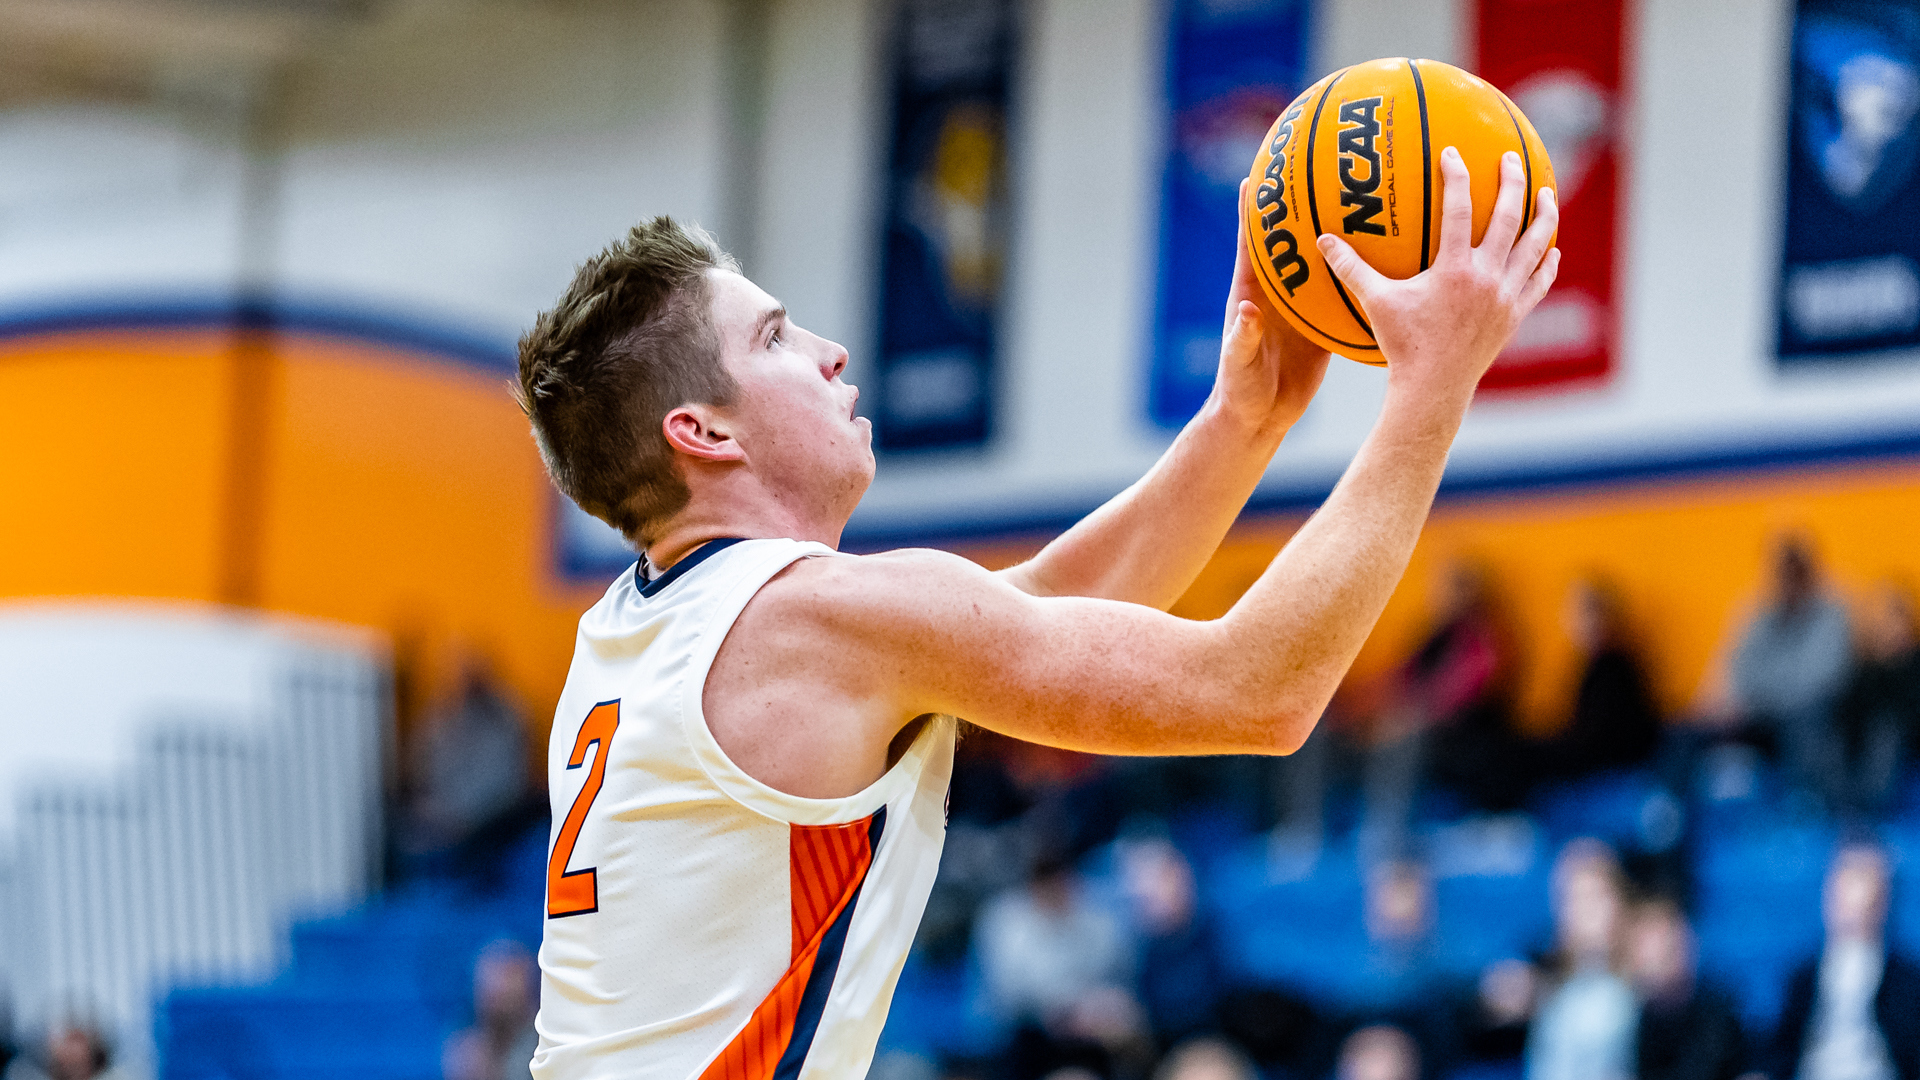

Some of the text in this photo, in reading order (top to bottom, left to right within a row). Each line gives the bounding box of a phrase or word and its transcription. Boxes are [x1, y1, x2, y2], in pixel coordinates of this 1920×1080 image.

[1256, 92, 1312, 298] Wilson
[1337, 95, 1387, 237] NCAA
[1386, 96, 1400, 237] OFFICIAL GAME BALL
[547, 698, 622, 920] 2
